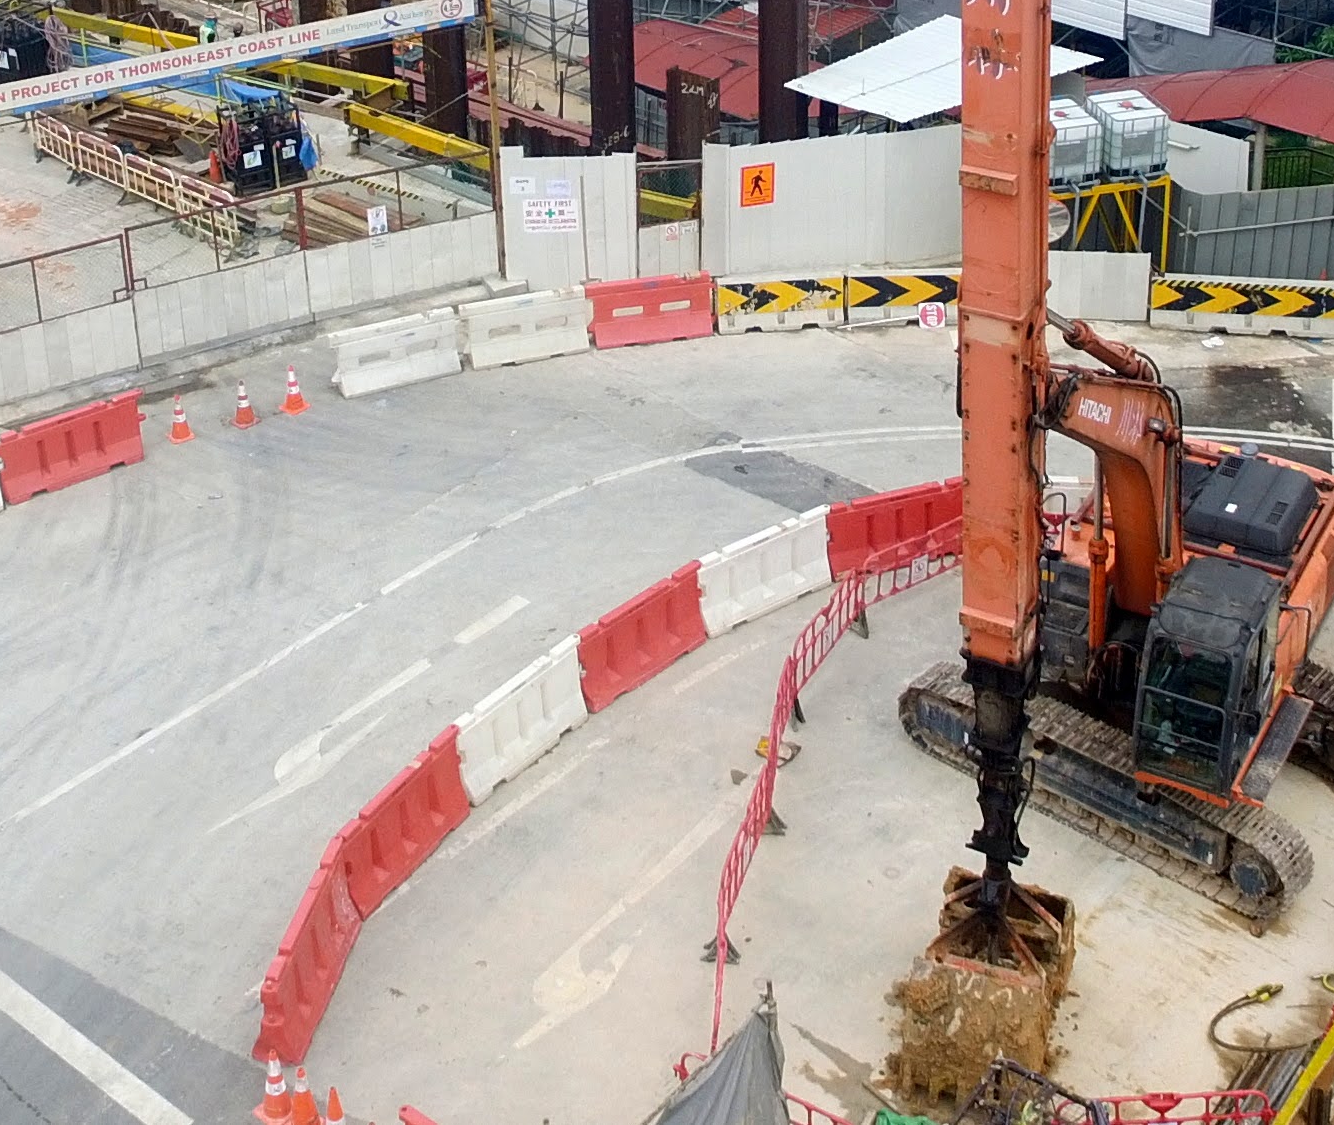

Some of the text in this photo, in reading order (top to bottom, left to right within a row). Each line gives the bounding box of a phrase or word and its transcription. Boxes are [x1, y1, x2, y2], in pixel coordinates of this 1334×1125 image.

[11, 79, 79, 101] PROJECT
[85, 70, 115, 87] FOR
[119, 47, 233, 78] THOMSON-EAST
[238, 37, 285, 55] COAST
[289, 29, 321, 46] LINE
[528, 200, 551, 208] SAFETY
[925, 304, 939, 327] STOP
[1078, 396, 1113, 425] HITACHI
